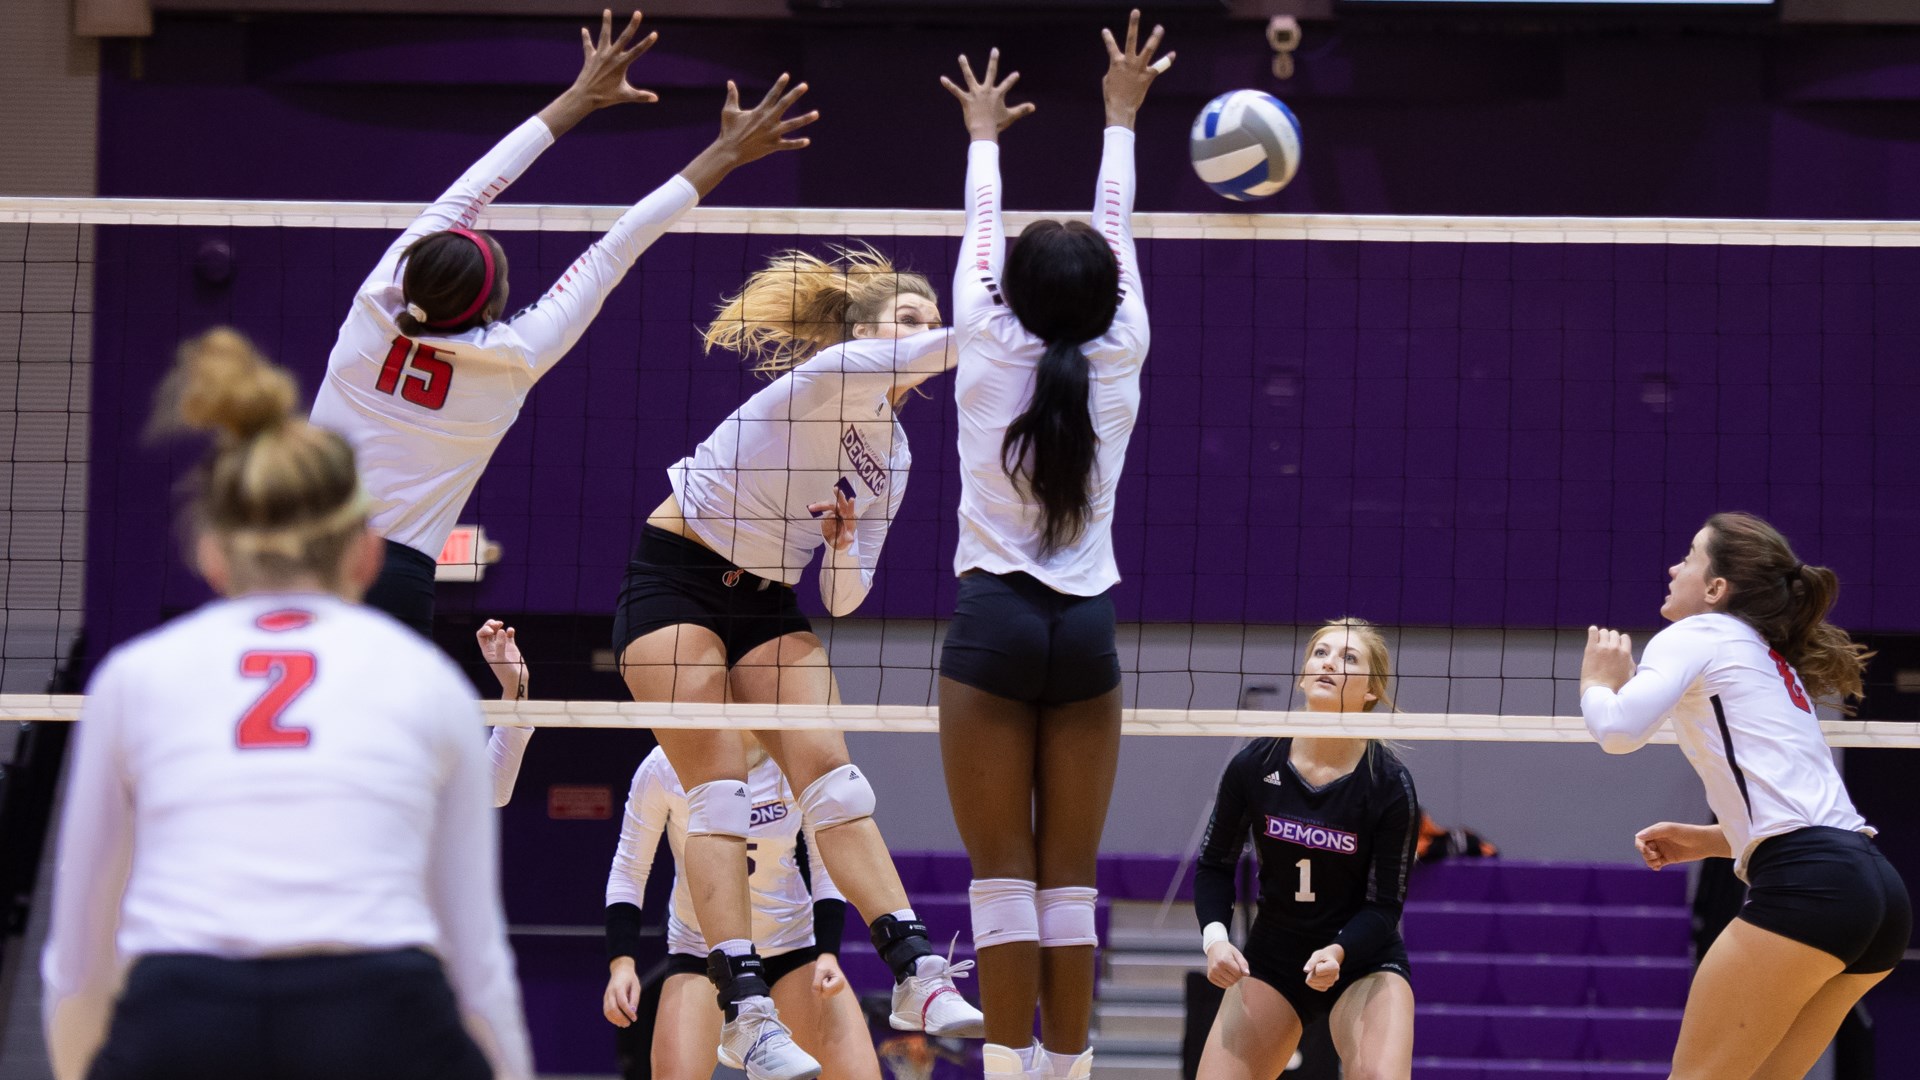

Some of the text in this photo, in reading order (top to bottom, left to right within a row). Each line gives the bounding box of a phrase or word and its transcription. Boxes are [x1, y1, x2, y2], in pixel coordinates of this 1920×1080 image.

[376, 335, 456, 411] 15
[844, 429, 886, 495] DEMONS
[235, 650, 317, 749] 2
[749, 803, 787, 825] ONS
[1269, 818, 1355, 852] DEMONS
[1295, 858, 1316, 902] 1
